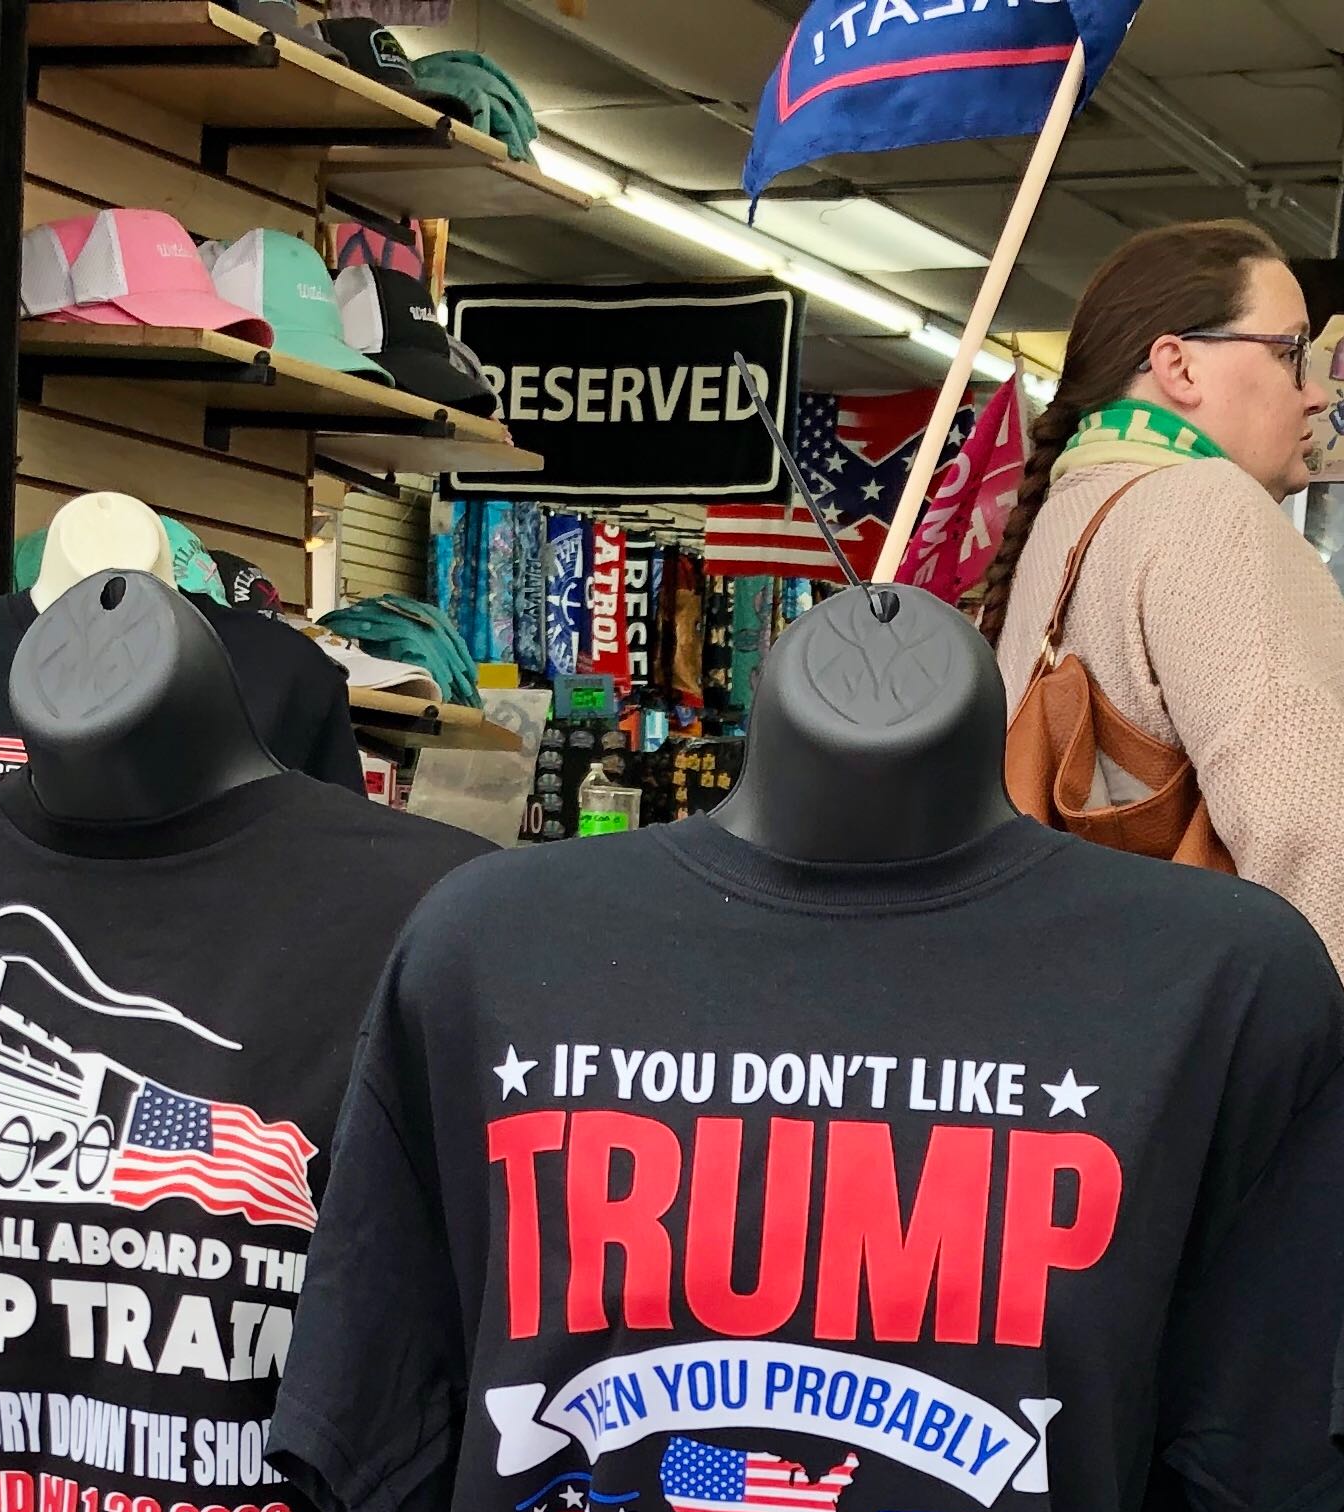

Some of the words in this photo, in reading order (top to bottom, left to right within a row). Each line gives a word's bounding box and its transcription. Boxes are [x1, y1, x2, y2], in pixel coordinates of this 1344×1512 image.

[552, 1043, 600, 1098] IF
[610, 1048, 716, 1103] YOU
[730, 1051, 898, 1110] DON'T
[908, 1056, 1027, 1118] LIKE
[47, 1229, 233, 1281] ABOARD
[487, 1109, 1124, 1348] TRUMP
[49, 1393, 126, 1466] DOWN
[132, 1409, 188, 1485] THE
[654, 1359, 749, 1416] YOU
[764, 1365, 1013, 1478] PROBABLY
